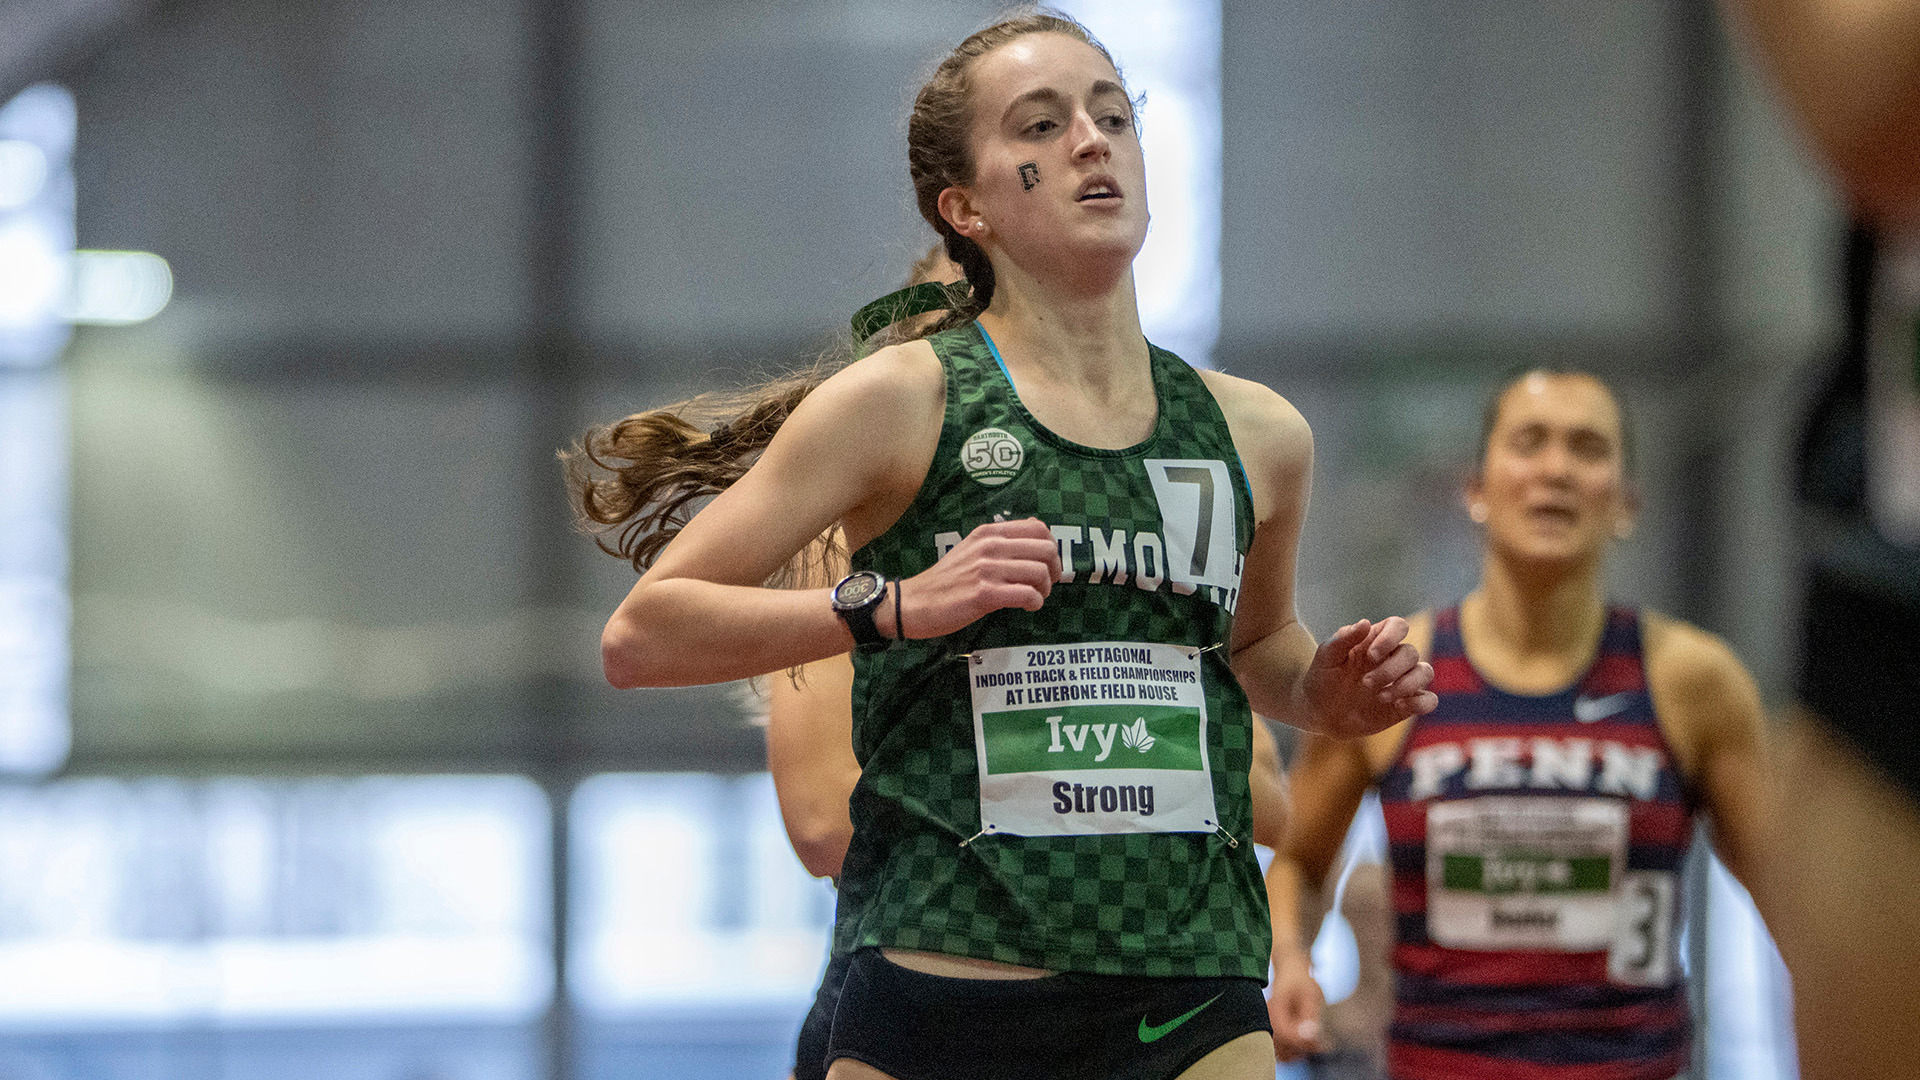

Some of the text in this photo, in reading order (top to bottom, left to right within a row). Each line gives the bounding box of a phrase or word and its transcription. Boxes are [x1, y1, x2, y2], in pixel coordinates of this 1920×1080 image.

[1162, 466, 1214, 577] 7
[976, 666, 1197, 689] INDOOR TRACK & FIELD CHAMPIONSHIPS
[1027, 647, 1152, 667] 2023 HEPTAGONAL
[1006, 683, 1179, 706] AT LEVERONE FIELD HOUSE
[1045, 715, 1118, 762] Ivy
[1409, 736, 1662, 800] PENN
[1052, 781, 1155, 816] Strong
[1624, 882, 1659, 972] 3
